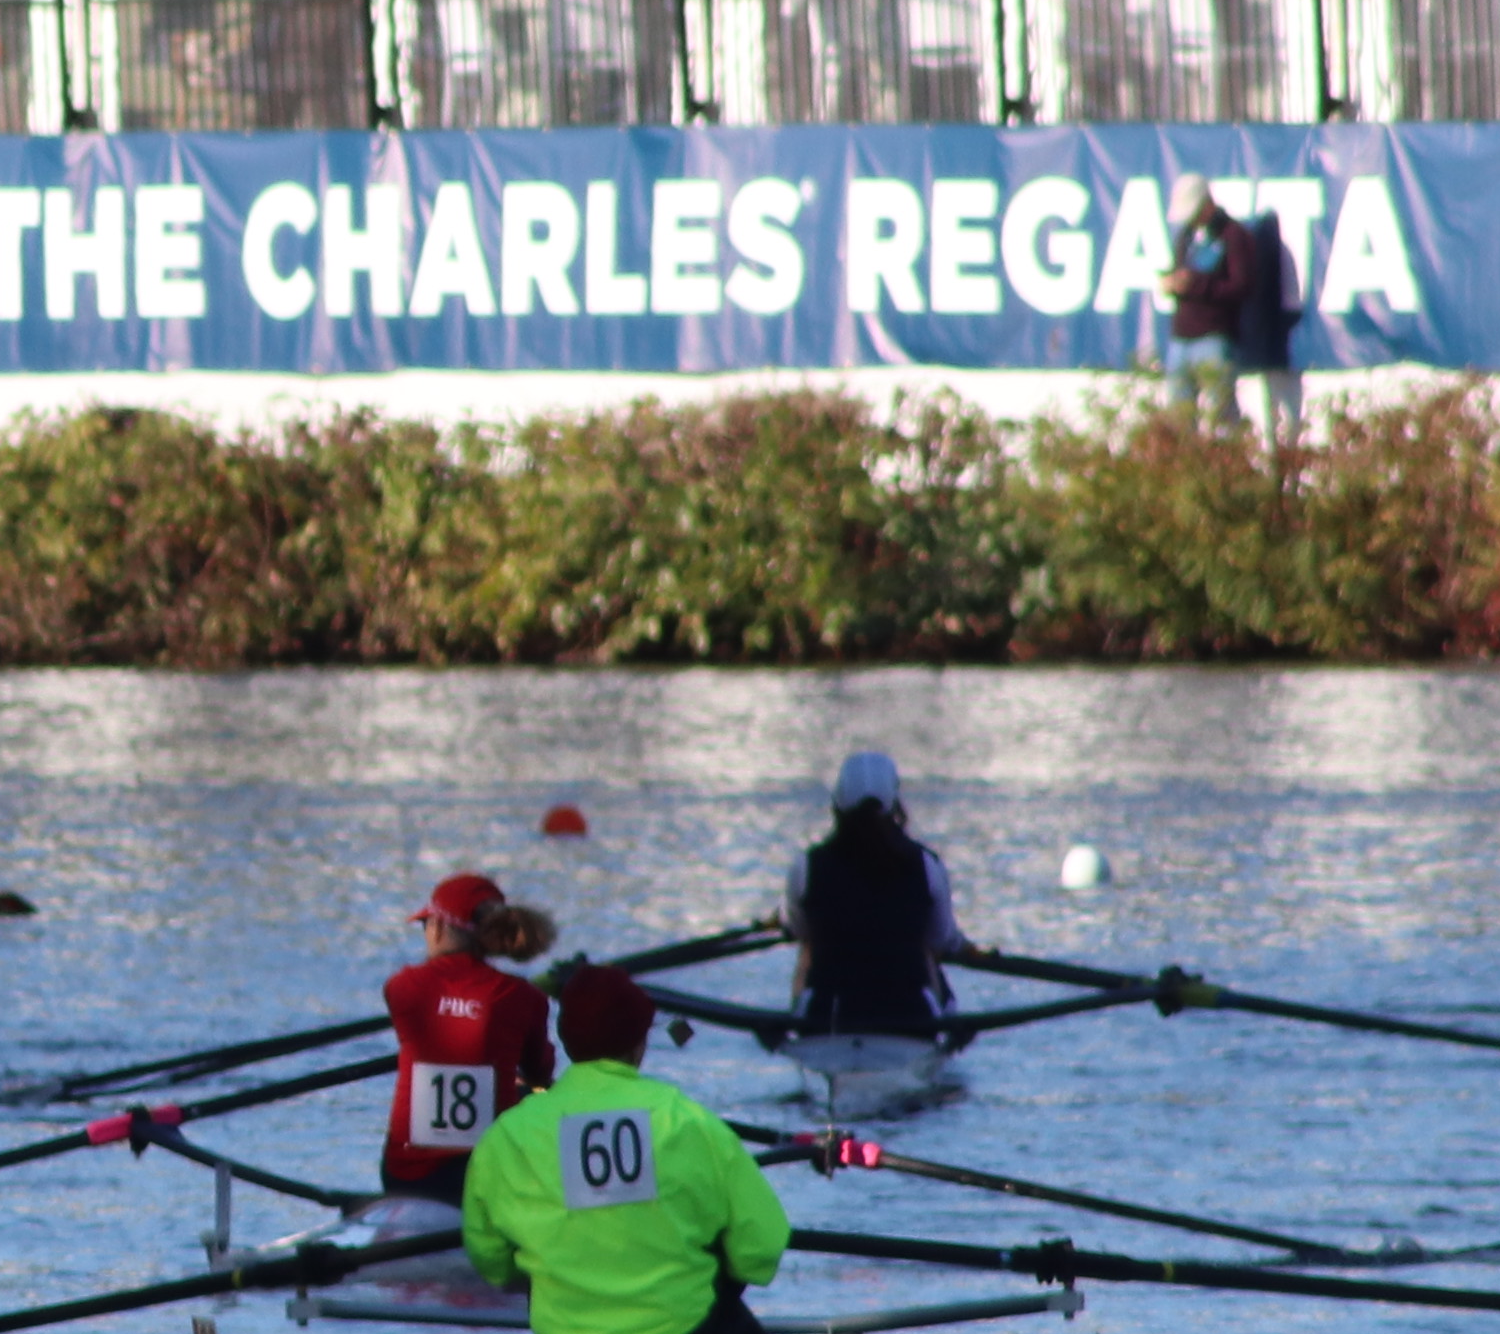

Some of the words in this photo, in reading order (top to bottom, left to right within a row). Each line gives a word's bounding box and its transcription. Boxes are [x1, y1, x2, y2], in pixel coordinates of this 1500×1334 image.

[242, 178, 804, 320] CHARLES
[431, 1073, 477, 1130] 18
[581, 1117, 642, 1187] 60
